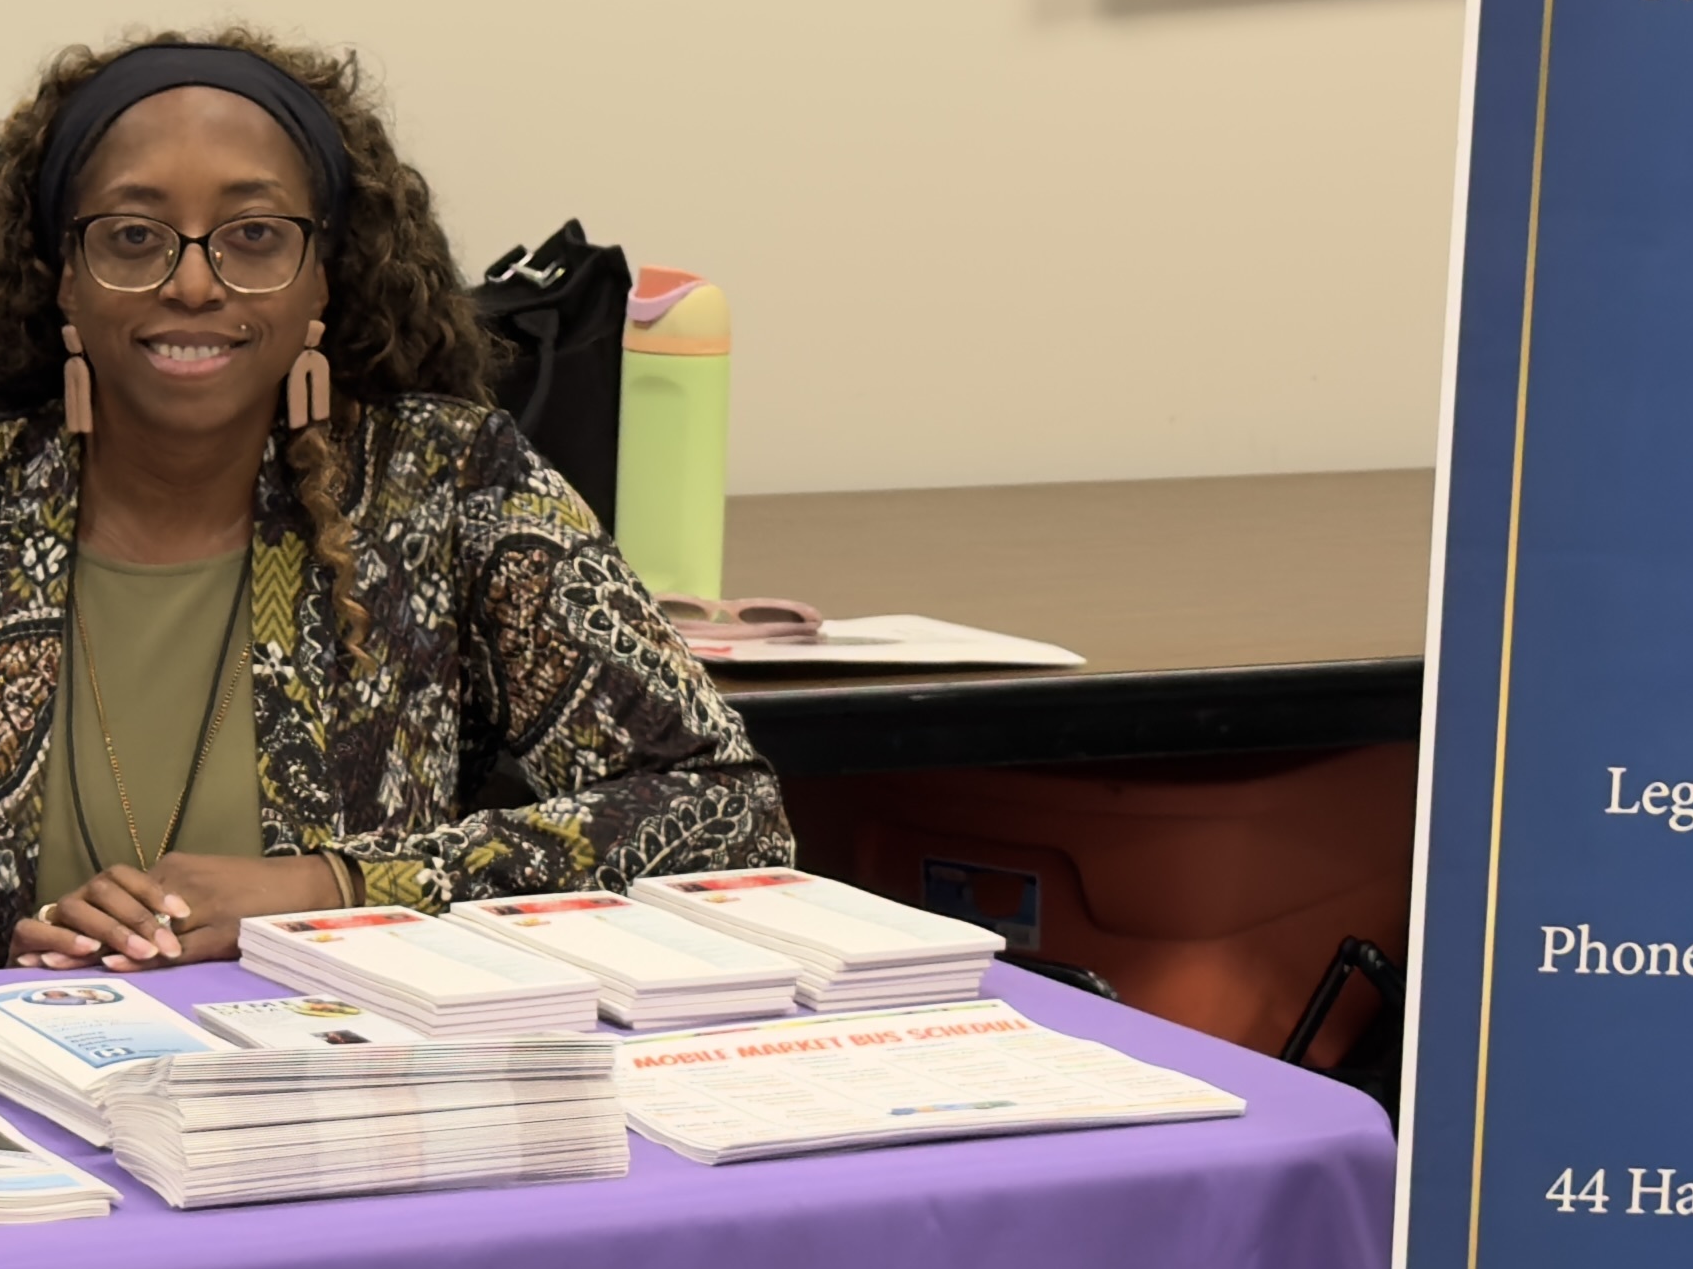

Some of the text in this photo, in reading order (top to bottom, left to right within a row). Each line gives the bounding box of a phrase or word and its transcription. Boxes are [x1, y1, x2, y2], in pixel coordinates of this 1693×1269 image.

[633, 1019, 1032, 1069] MOBILE MARKET BUS SCHEDULE
[1546, 1168, 1609, 1213] 44
